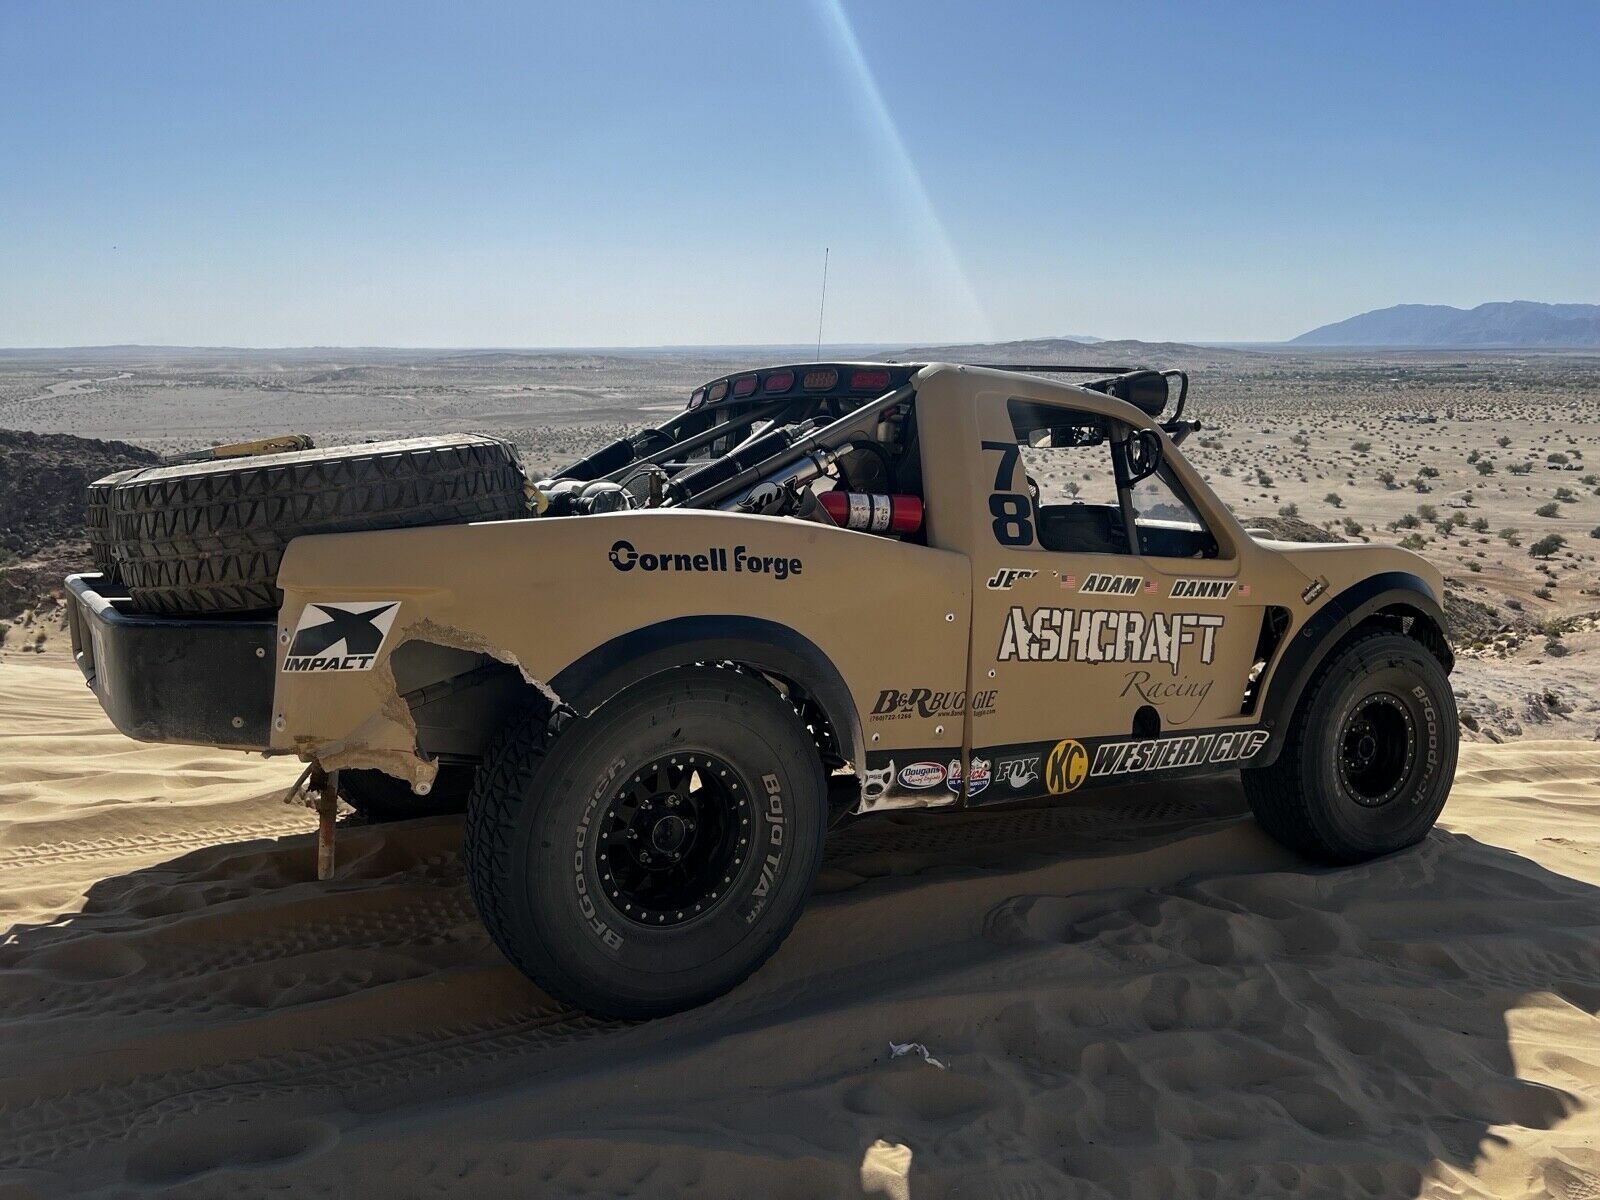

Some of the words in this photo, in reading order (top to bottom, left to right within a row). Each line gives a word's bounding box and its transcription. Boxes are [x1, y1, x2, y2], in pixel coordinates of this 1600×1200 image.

[608, 540, 727, 572] Cornell
[734, 545, 803, 580] Forge
[1081, 574, 1142, 595] ADAM
[1172, 580, 1234, 598] DANNY
[997, 605, 1225, 675] ASHCRAFT
[283, 655, 376, 672] IMPACT
[870, 688, 940, 718] B&R
[1119, 670, 1214, 725] Racing
[995, 757, 1040, 788] FOX
[1050, 743, 1084, 791] KC
[1090, 734, 1214, 777] WESTERN
[1209, 730, 1270, 763] CNC
[761, 773, 788, 846] Baja
[574, 757, 627, 951] BFGoodrich
[751, 852, 782, 897] T/A
